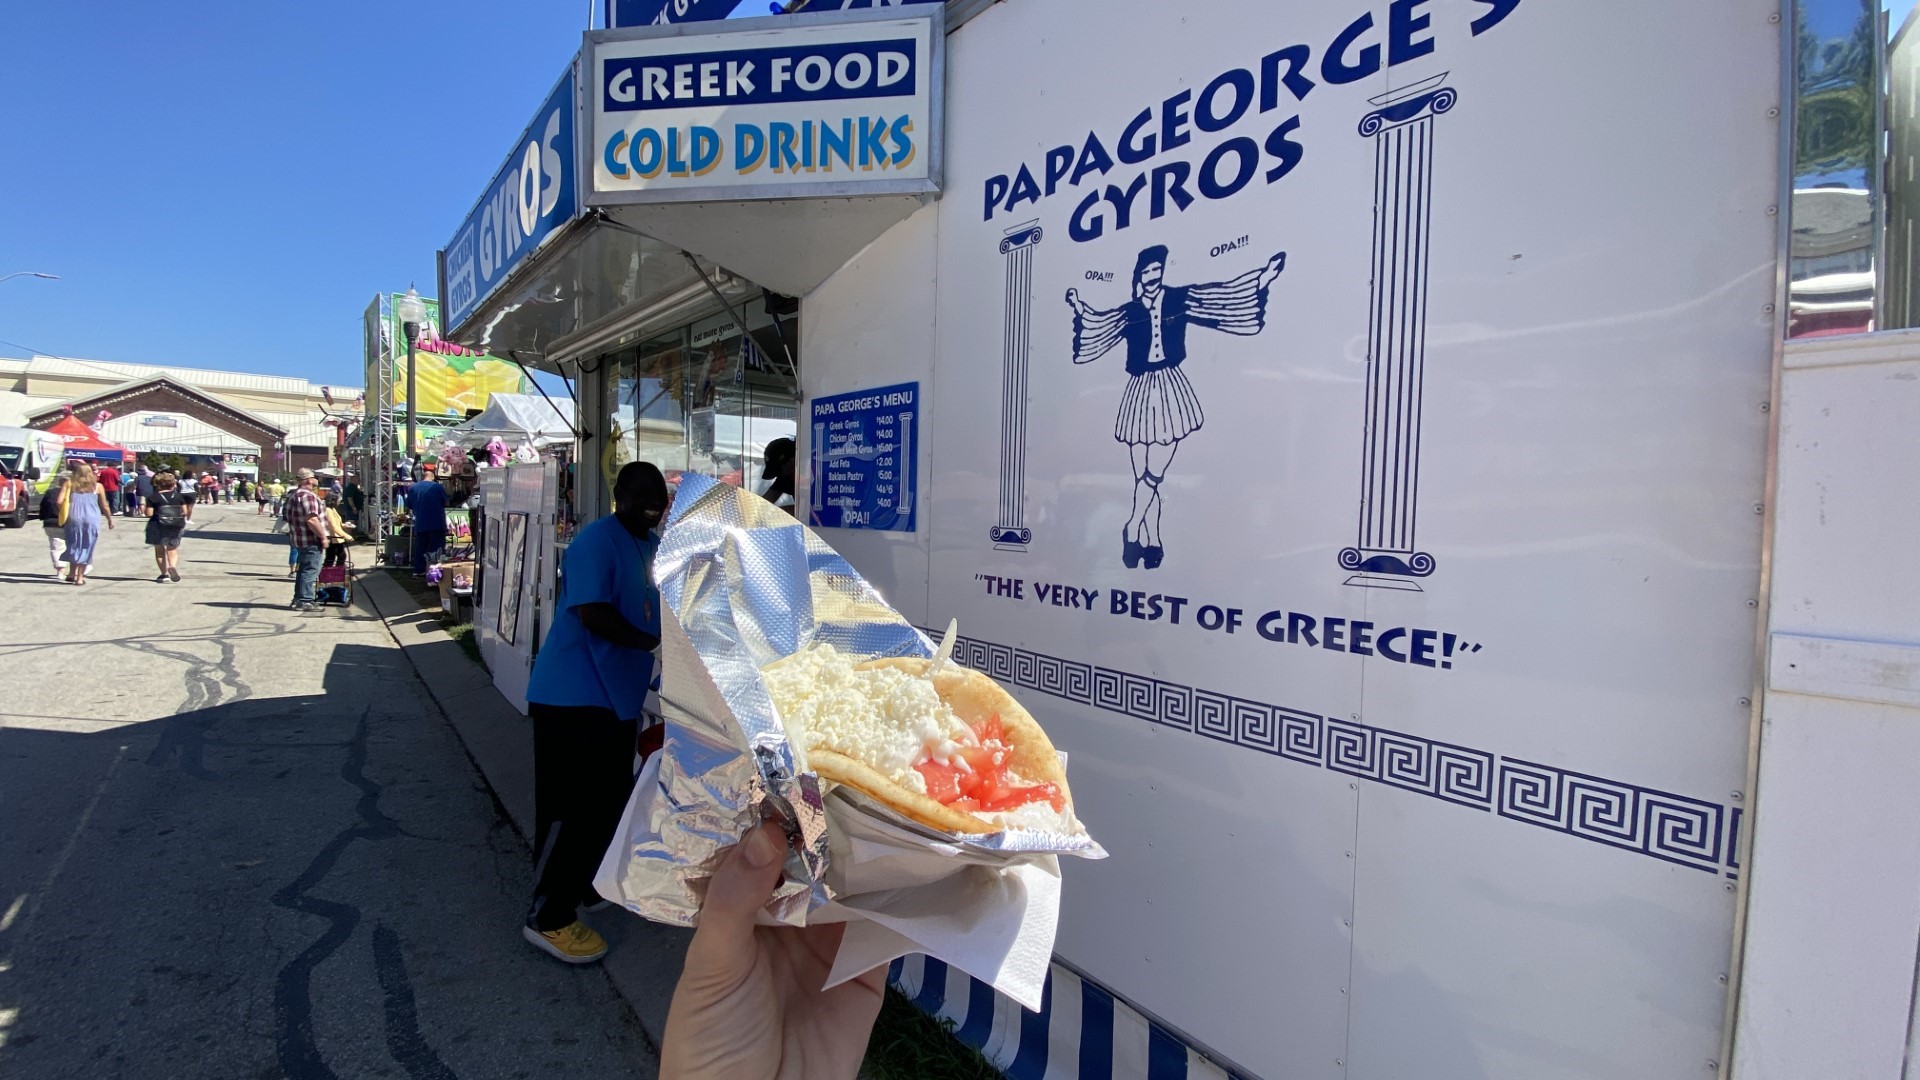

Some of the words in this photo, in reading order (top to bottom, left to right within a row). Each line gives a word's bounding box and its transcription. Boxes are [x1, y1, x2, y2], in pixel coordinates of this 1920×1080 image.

[608, 60, 756, 103] GREEK
[770, 51, 910, 93] FOOD
[603, 125, 724, 180] COLD
[734, 113, 916, 175] DRINKS
[1068, 114, 1304, 243] GYROS
[479, 107, 562, 282] GYROS
[1210, 234, 1249, 258] OPA!!!
[448, 229, 474, 283] CHICKEN
[1085, 270, 1114, 283] OPA!!!
[450, 270, 472, 315] GYROS
[703, 328, 718, 340] more
[718, 321, 735, 337] gyros
[814, 403, 836, 417] PAPA
[838, 396, 881, 413] GEORGE'S
[883, 390, 913, 407] MENU
[829, 421, 844, 431] Greek
[844, 420, 860, 430] Gyros
[829, 433, 847, 444] Chicken
[848, 432, 863, 443] Gyros
[858, 444, 873, 455] Gyros
[829, 460, 839, 468] Add
[839, 459, 850, 468] Feta
[828, 472, 846, 481] Baklava
[847, 471, 864, 482] Pastry
[828, 484, 839, 494] Soft
[839, 484, 855, 494] Drinks
[827, 497, 845, 506] Bottled
[845, 498, 861, 507] Water
[844, 511, 870, 524] OPA!!
[1033, 581, 1099, 611] VERY
[1109, 588, 1188, 625] BEST
[1196, 604, 1243, 634] OF
